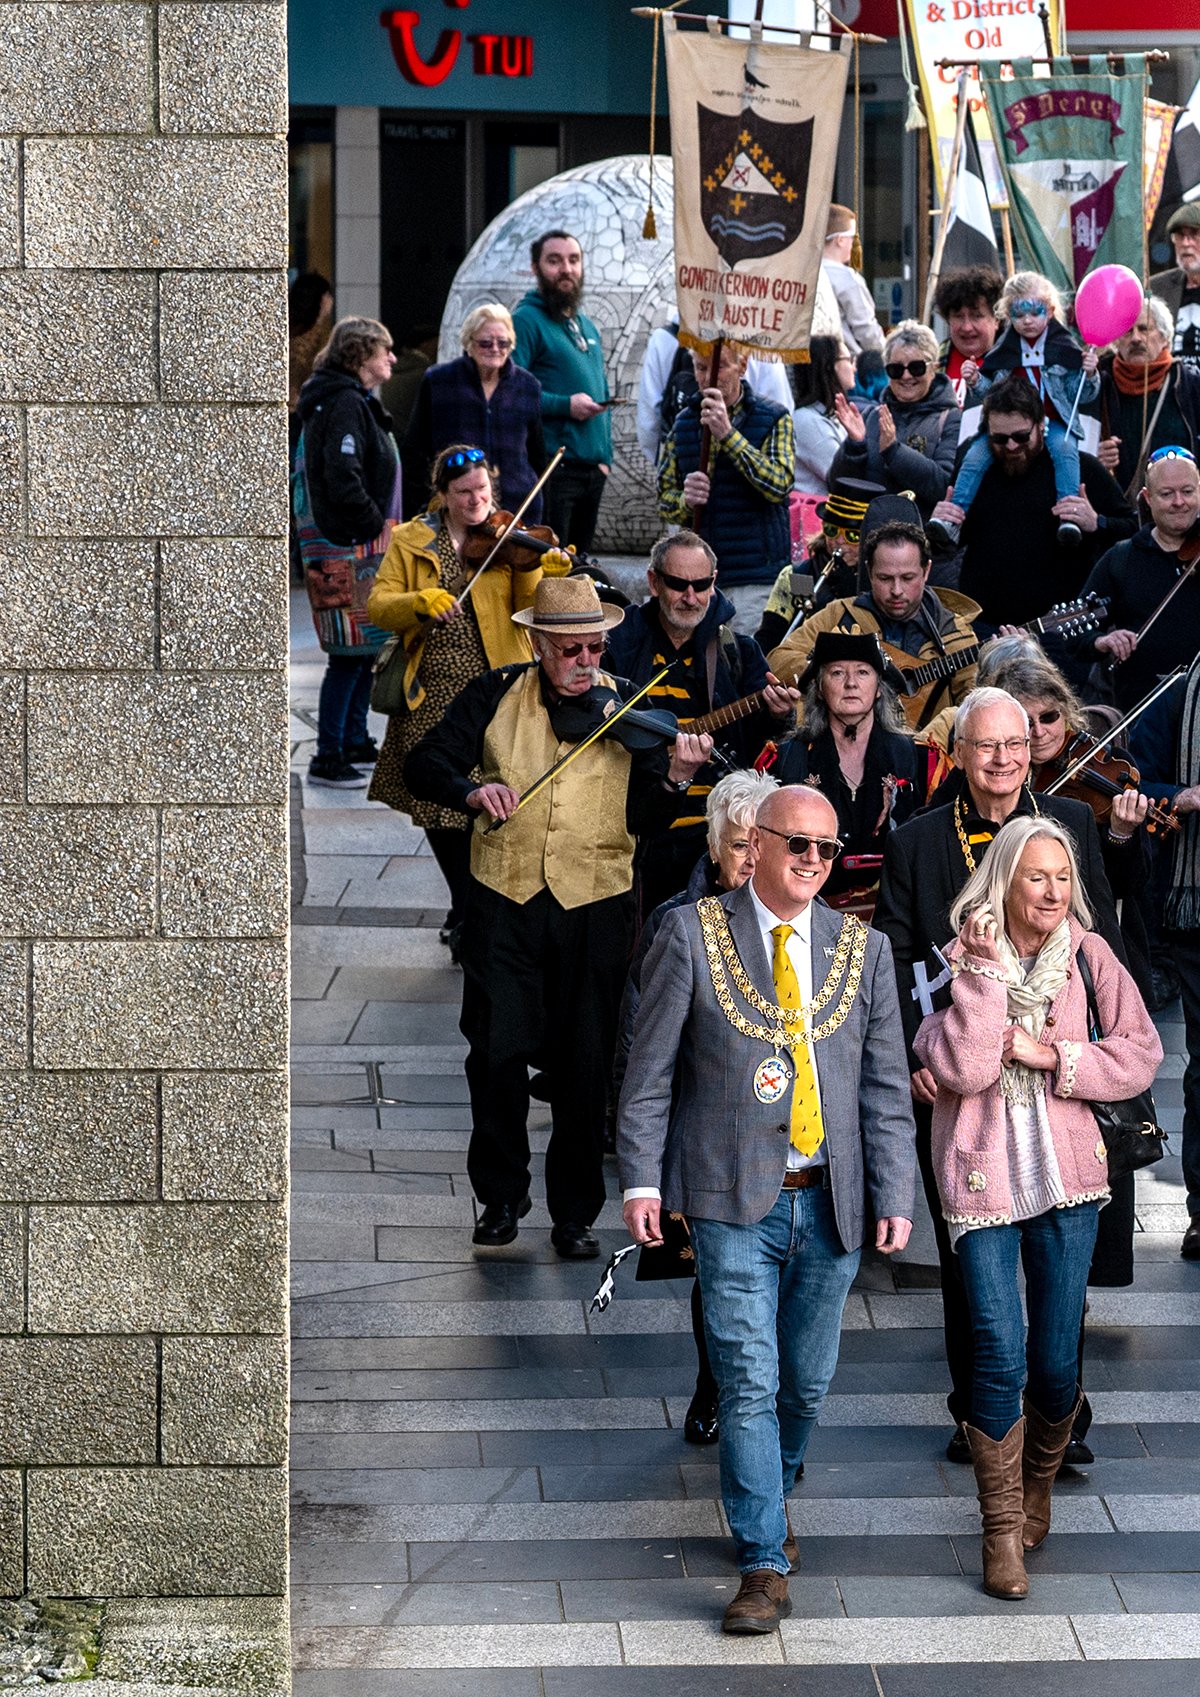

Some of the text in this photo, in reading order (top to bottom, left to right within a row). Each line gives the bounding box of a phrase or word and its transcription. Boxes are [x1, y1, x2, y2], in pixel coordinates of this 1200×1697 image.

[927, 0, 1036, 23] & District
[965, 27, 1002, 49] Old
[469, 34, 533, 77] TUI
[722, 304, 785, 332] AUSTLE
